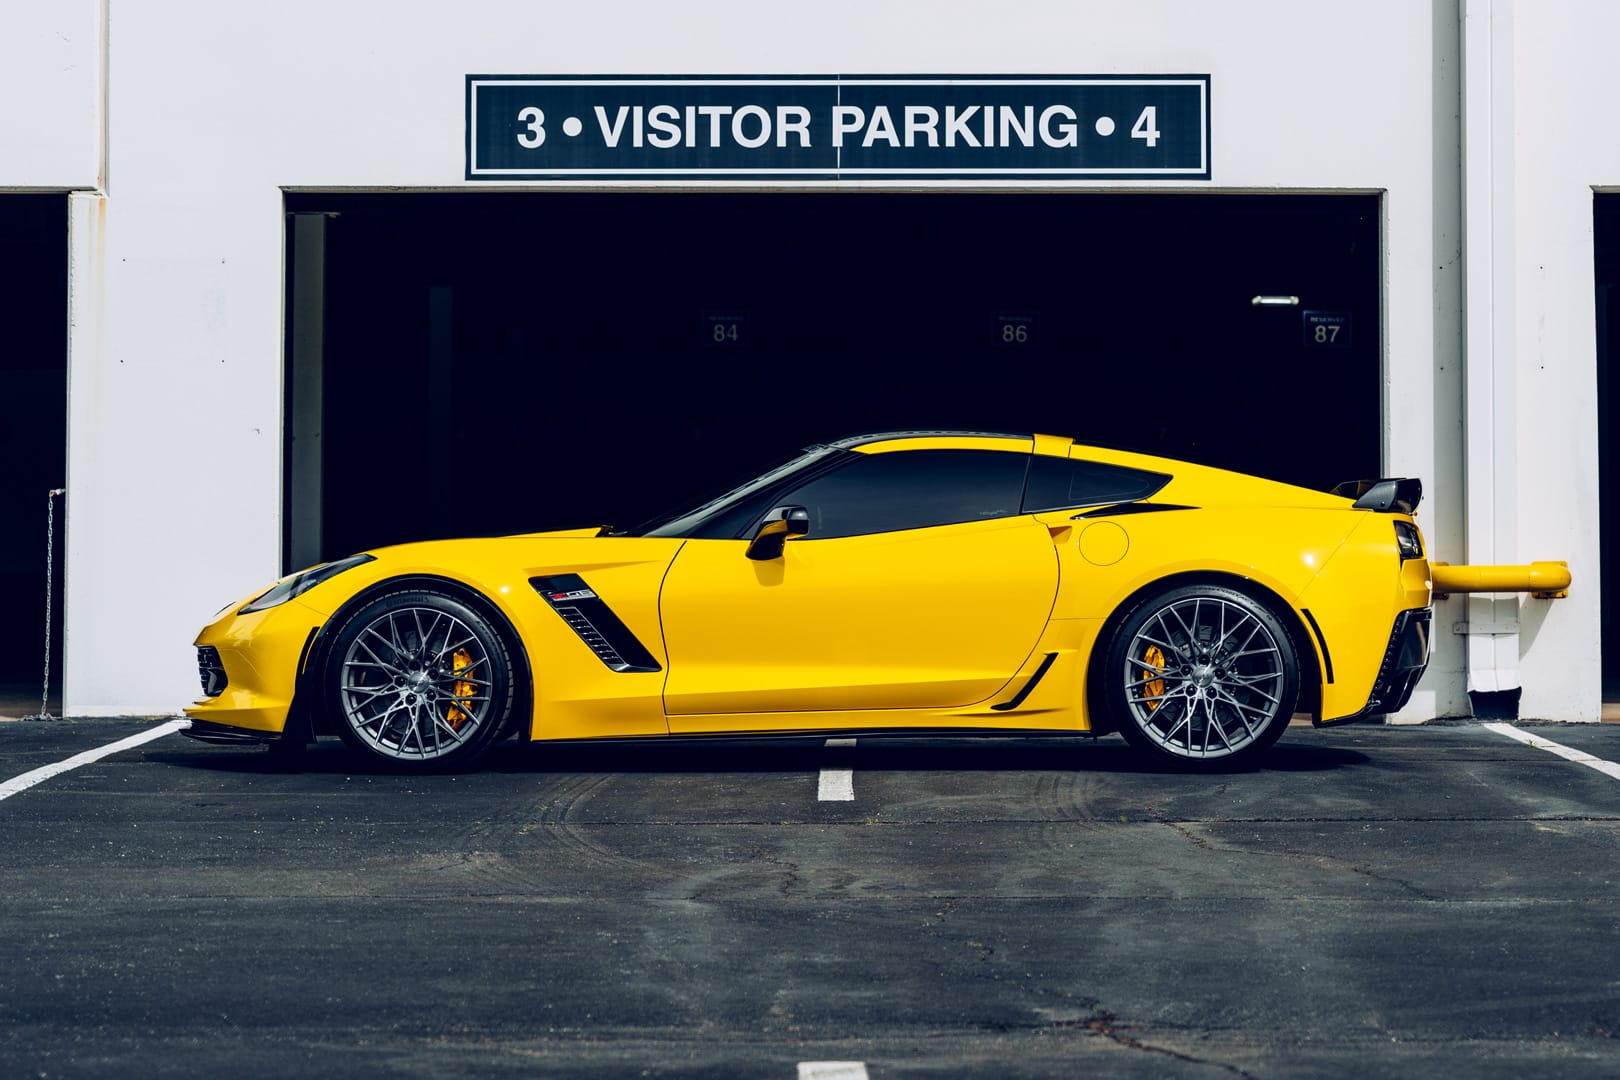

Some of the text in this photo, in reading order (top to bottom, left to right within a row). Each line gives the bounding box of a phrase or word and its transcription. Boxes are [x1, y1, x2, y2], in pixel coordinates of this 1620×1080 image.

[517, 105, 1161, 149] 3 VISITOR PARKING 4
[713, 323, 739, 342] 84
[1002, 324, 1028, 343] 86
[1314, 324, 1341, 343] 87
